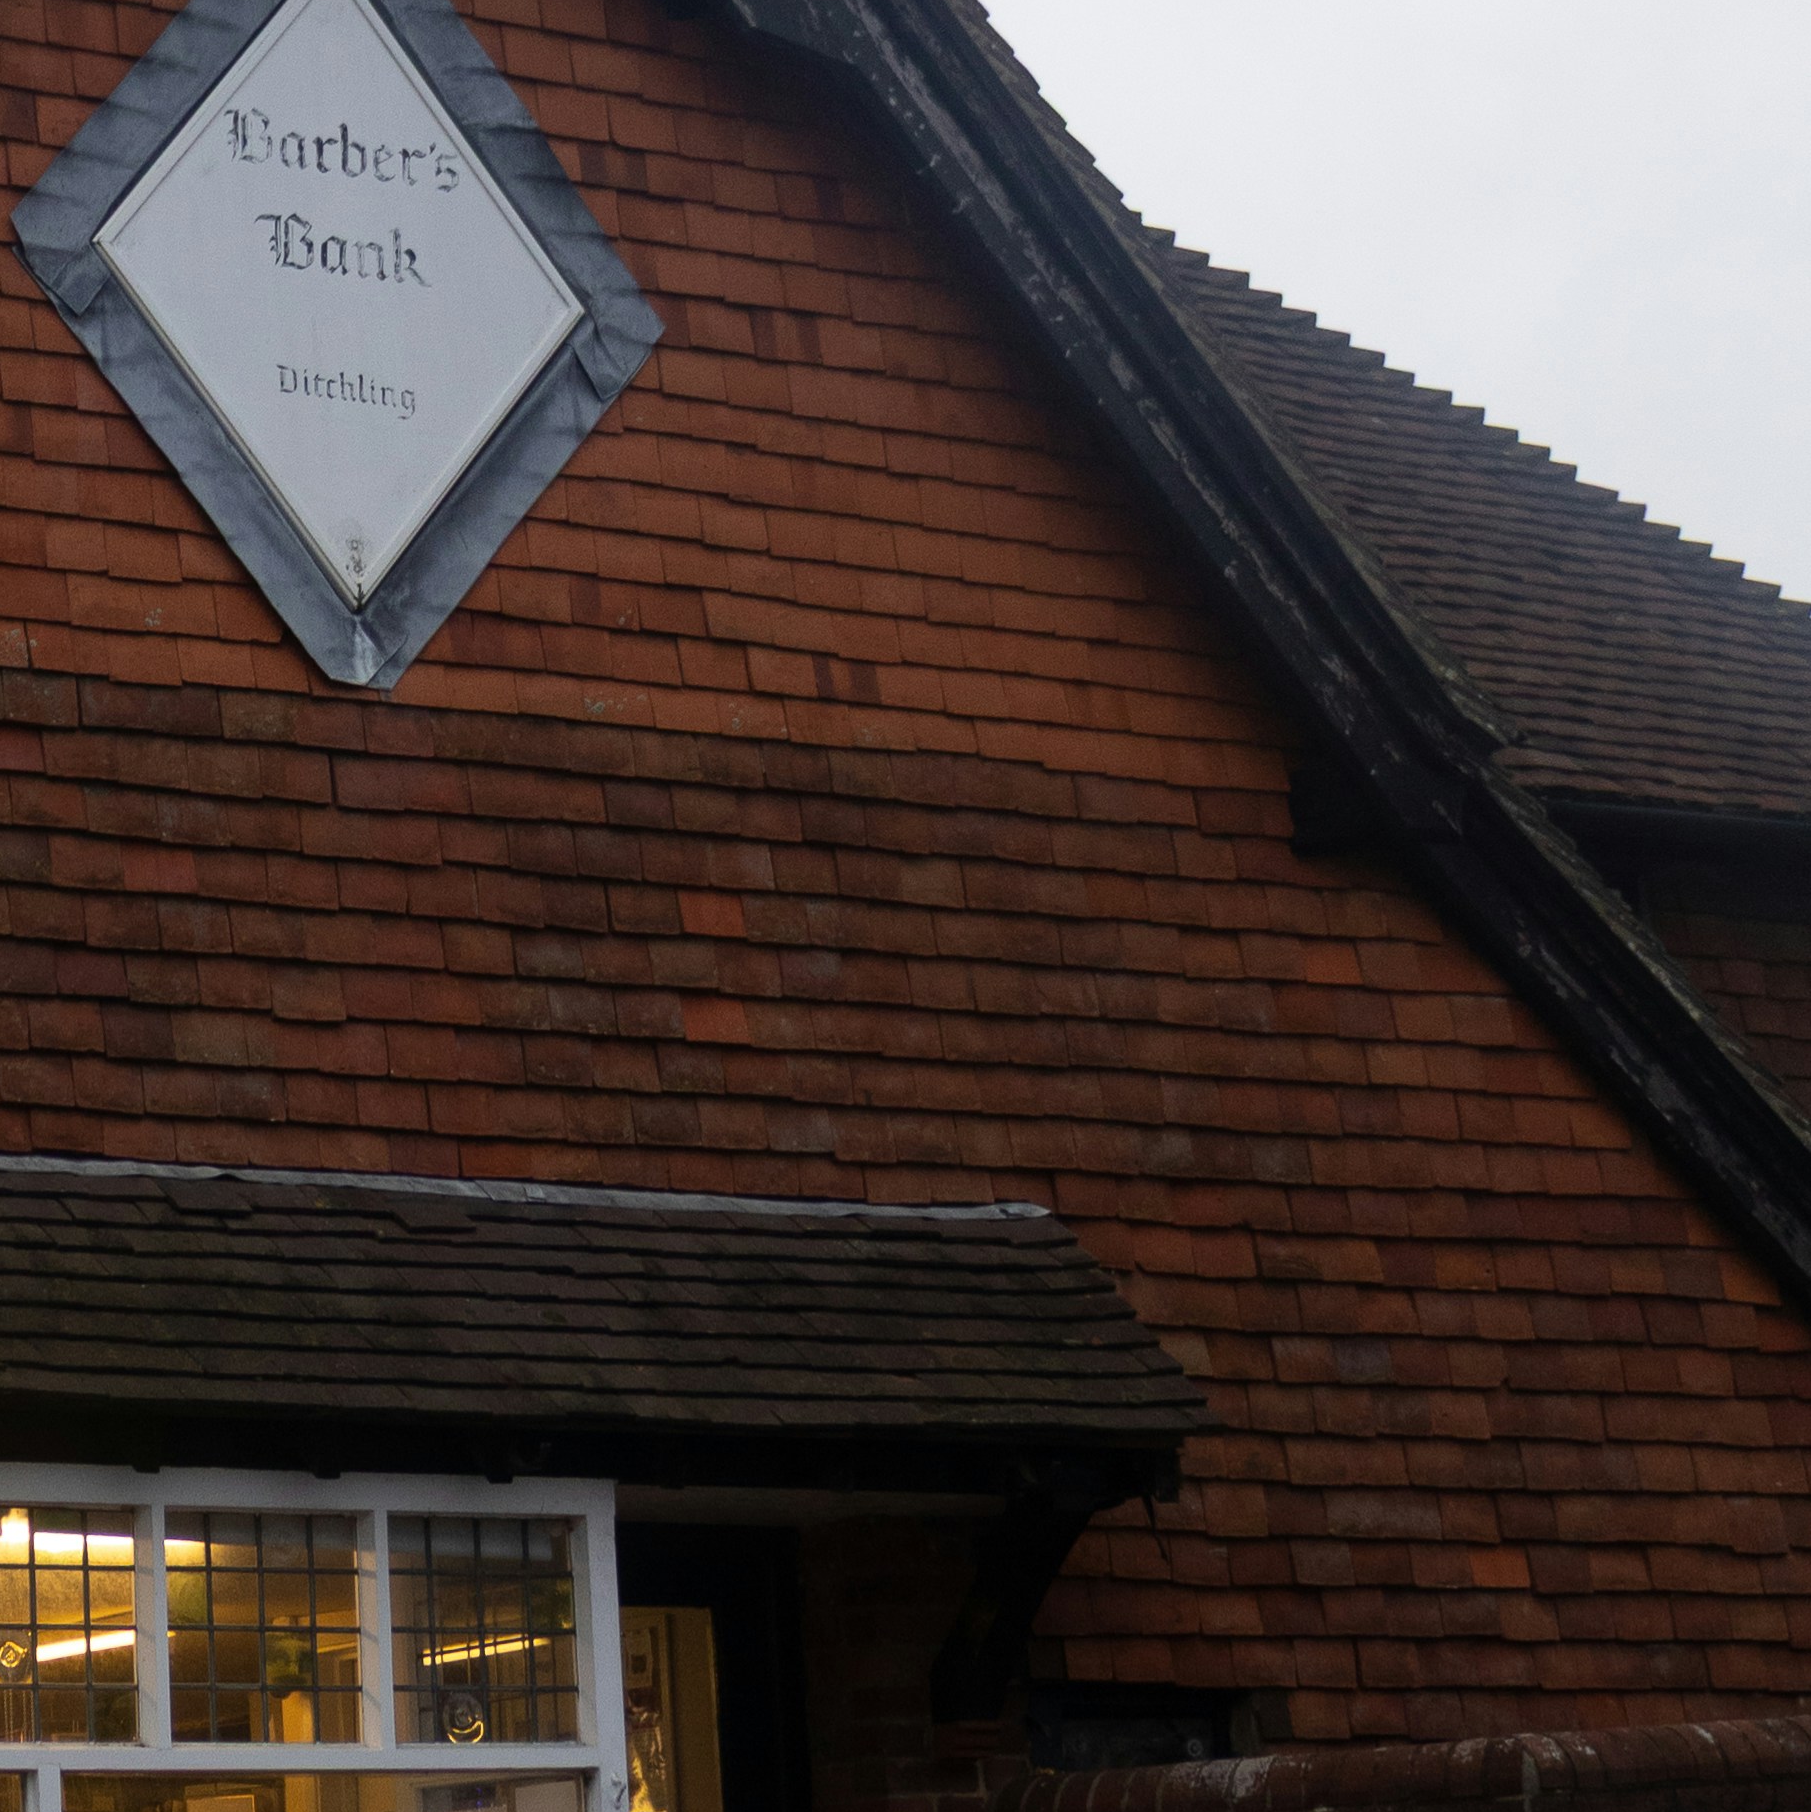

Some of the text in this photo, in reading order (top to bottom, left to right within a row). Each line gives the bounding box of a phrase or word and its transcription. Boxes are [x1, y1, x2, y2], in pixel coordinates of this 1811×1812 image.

[224, 107, 461, 193] Barber's
[255, 213, 431, 288] Bank
[276, 364, 417, 420] Ditchling
